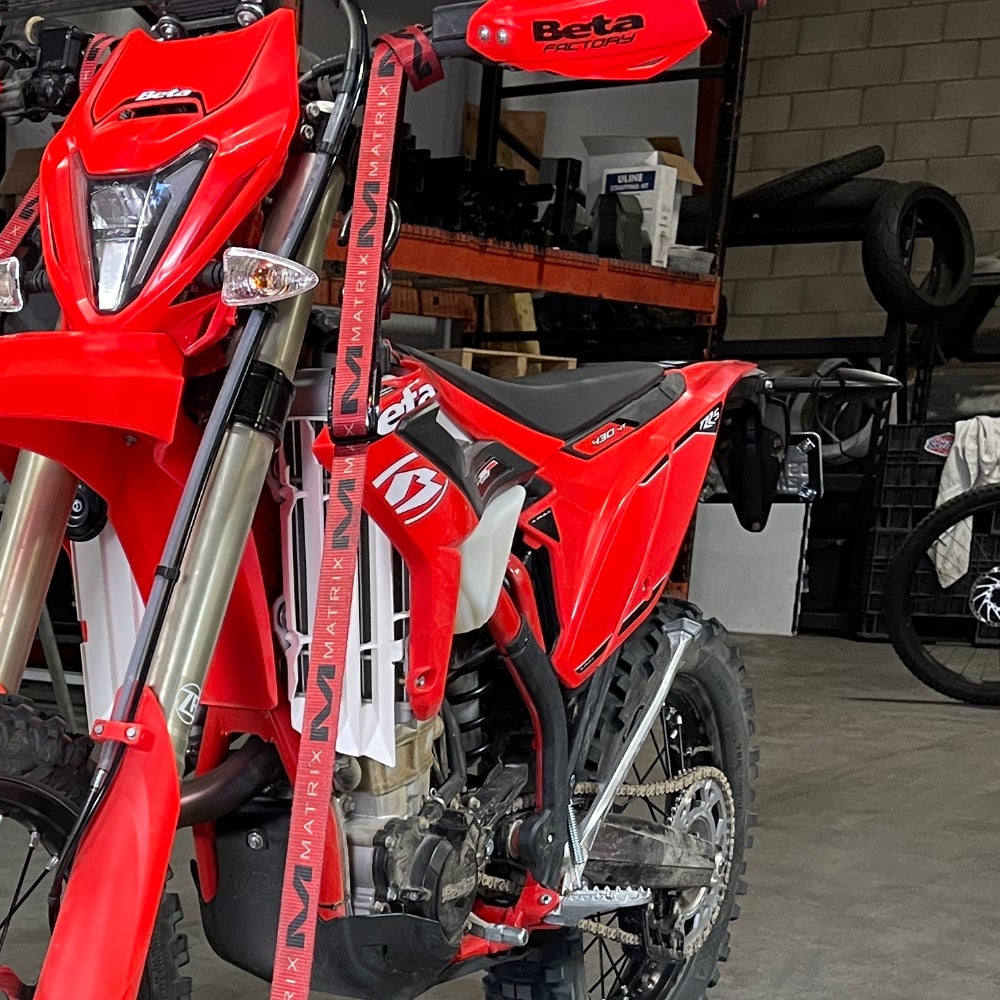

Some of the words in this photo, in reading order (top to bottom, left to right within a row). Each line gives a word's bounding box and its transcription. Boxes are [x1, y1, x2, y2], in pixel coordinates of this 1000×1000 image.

[533, 14, 644, 42] Beta
[543, 33, 636, 52] FACTORY
[135, 88, 192, 101] Beta
[369, 84, 389, 177] MATRIX
[351, 254, 368, 341] MATRIX
[377, 378, 436, 436] eta
[592, 428, 615, 446] 430
[323, 557, 344, 659] MATRIX
[300, 750, 322, 859] MATRIX
